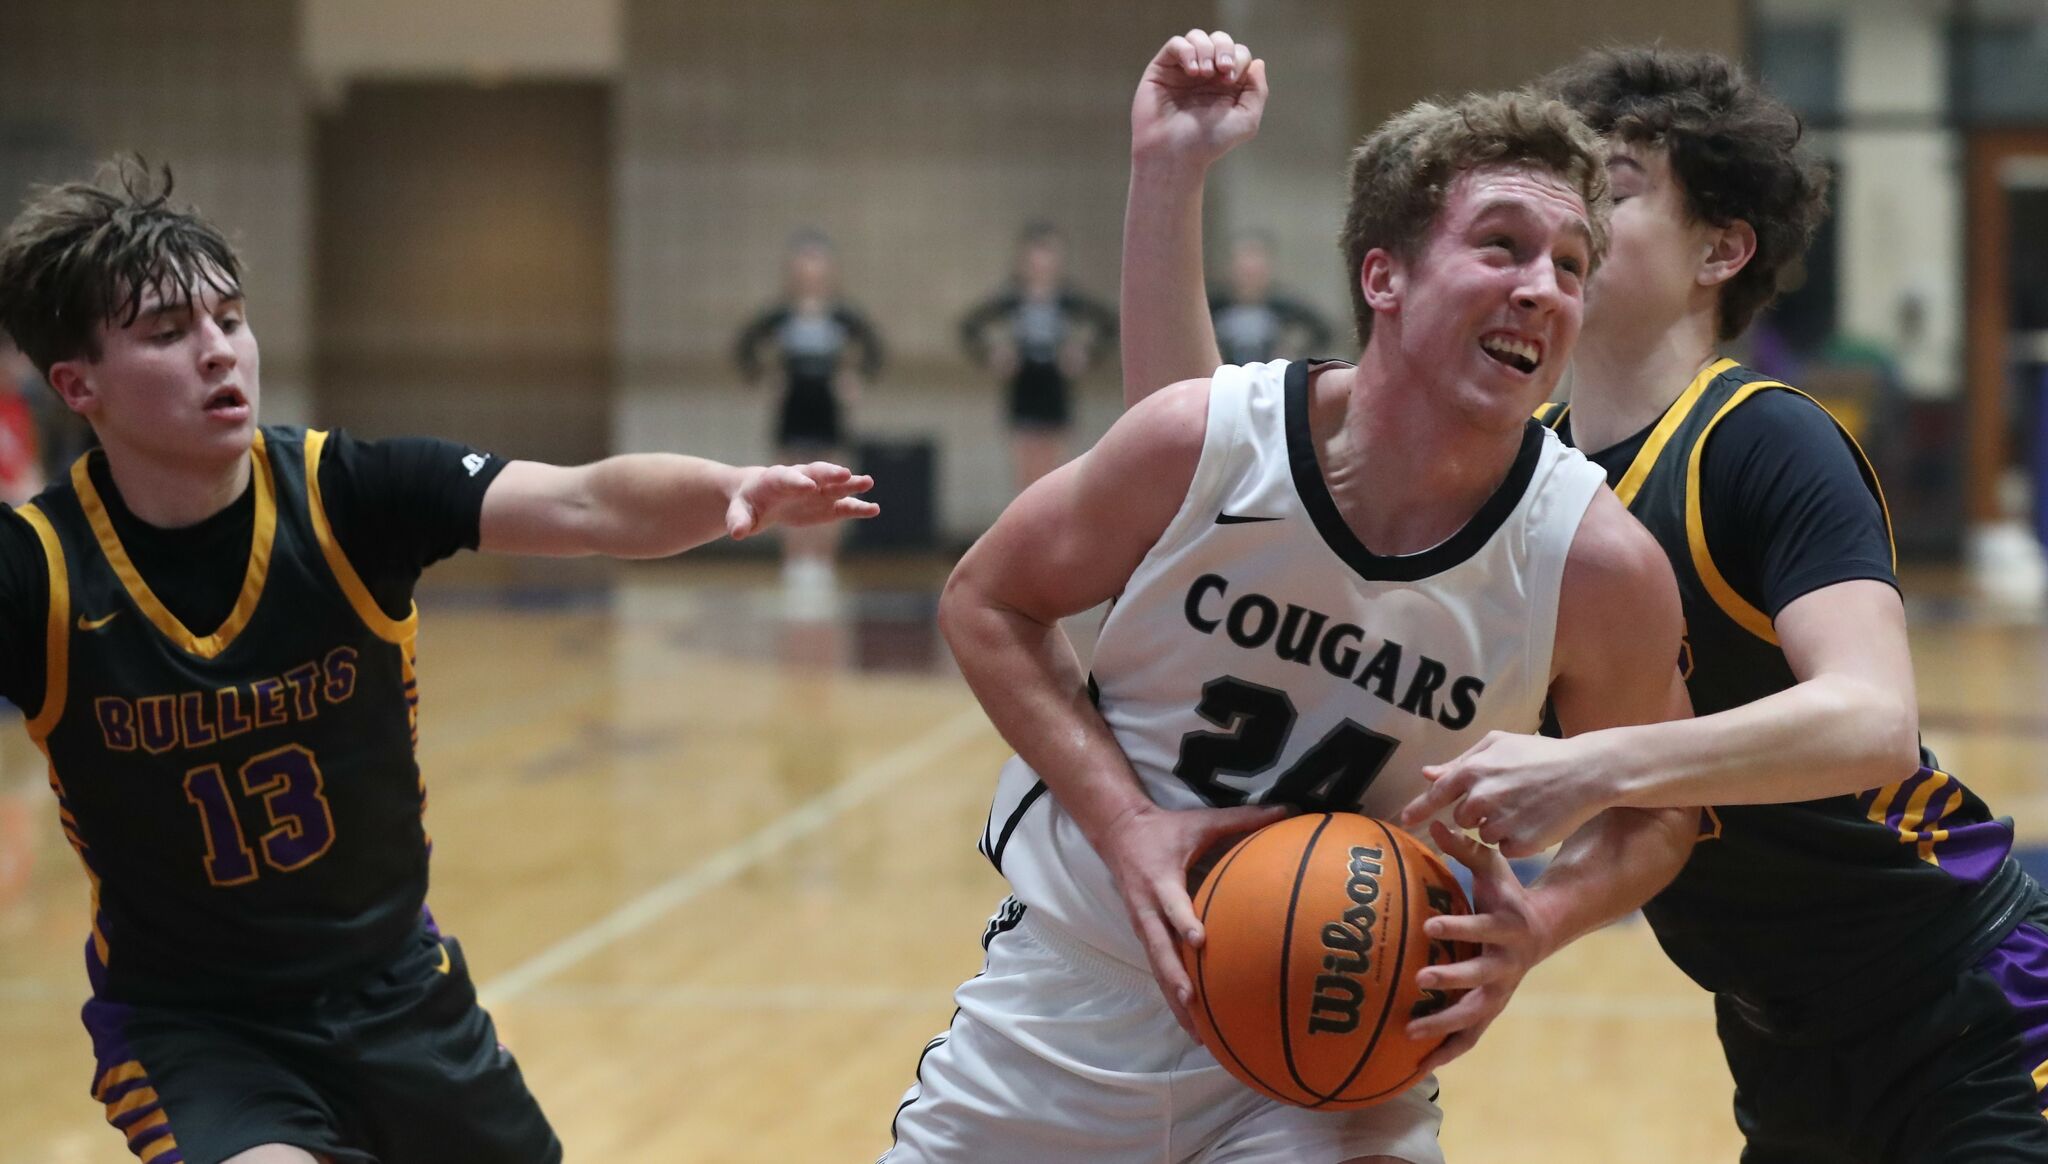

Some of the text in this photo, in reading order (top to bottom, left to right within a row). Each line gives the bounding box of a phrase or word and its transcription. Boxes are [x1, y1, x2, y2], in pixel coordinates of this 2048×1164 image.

[94, 645, 359, 755] BULLETS
[1184, 573, 1486, 731] COUGARS
[182, 743, 336, 886] 13
[1172, 674, 1402, 813] 24
[1308, 845, 1384, 1035] Wilson
